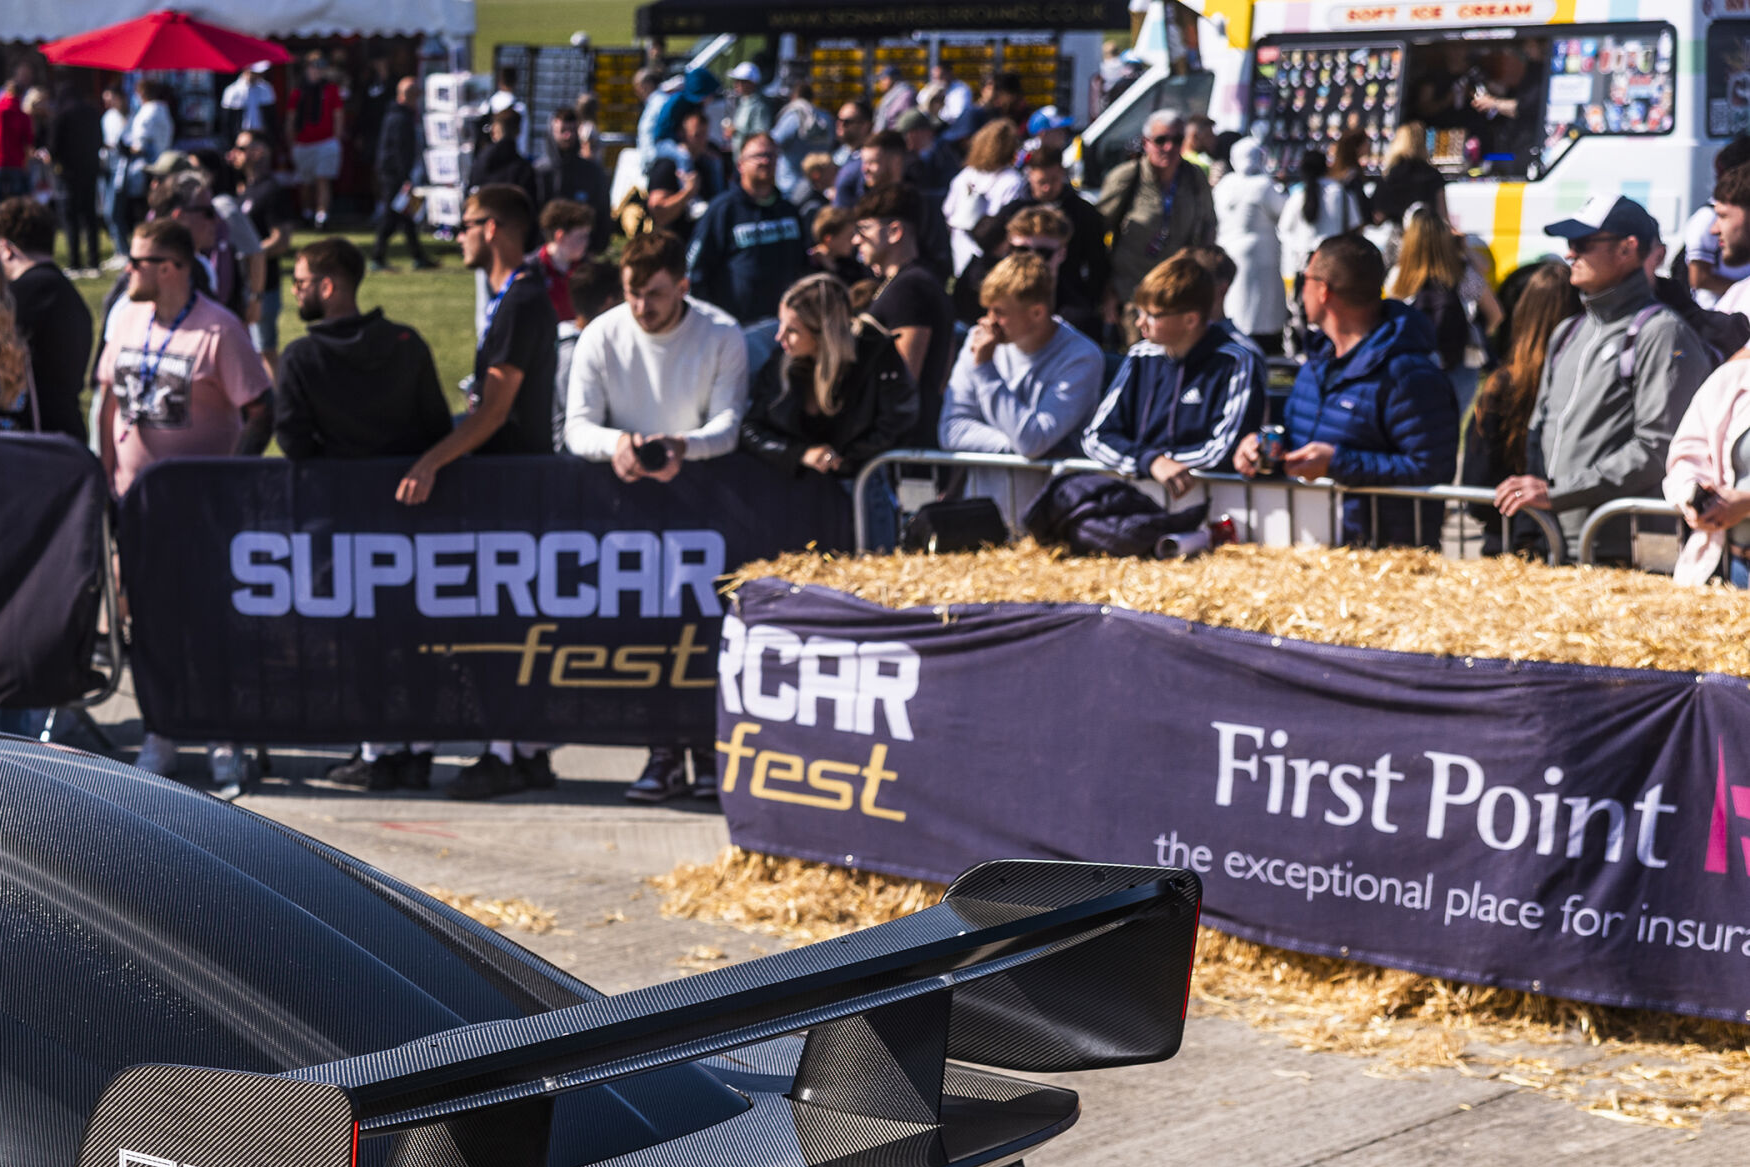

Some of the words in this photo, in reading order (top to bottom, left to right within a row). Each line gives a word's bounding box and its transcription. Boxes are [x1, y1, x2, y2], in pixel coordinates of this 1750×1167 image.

[1411, 6, 1443, 20] ICE
[1458, 3, 1533, 19] CREAM
[229, 529, 727, 618] SUPERCAR
[445, 623, 717, 688] fest
[714, 721, 907, 823] fest
[1210, 720, 1406, 834] First
[1423, 750, 1678, 869] Point
[1152, 829, 1213, 874] the
[1223, 849, 1434, 910] exceptional
[1444, 881, 1545, 930] place
[1560, 895, 1626, 938] for
